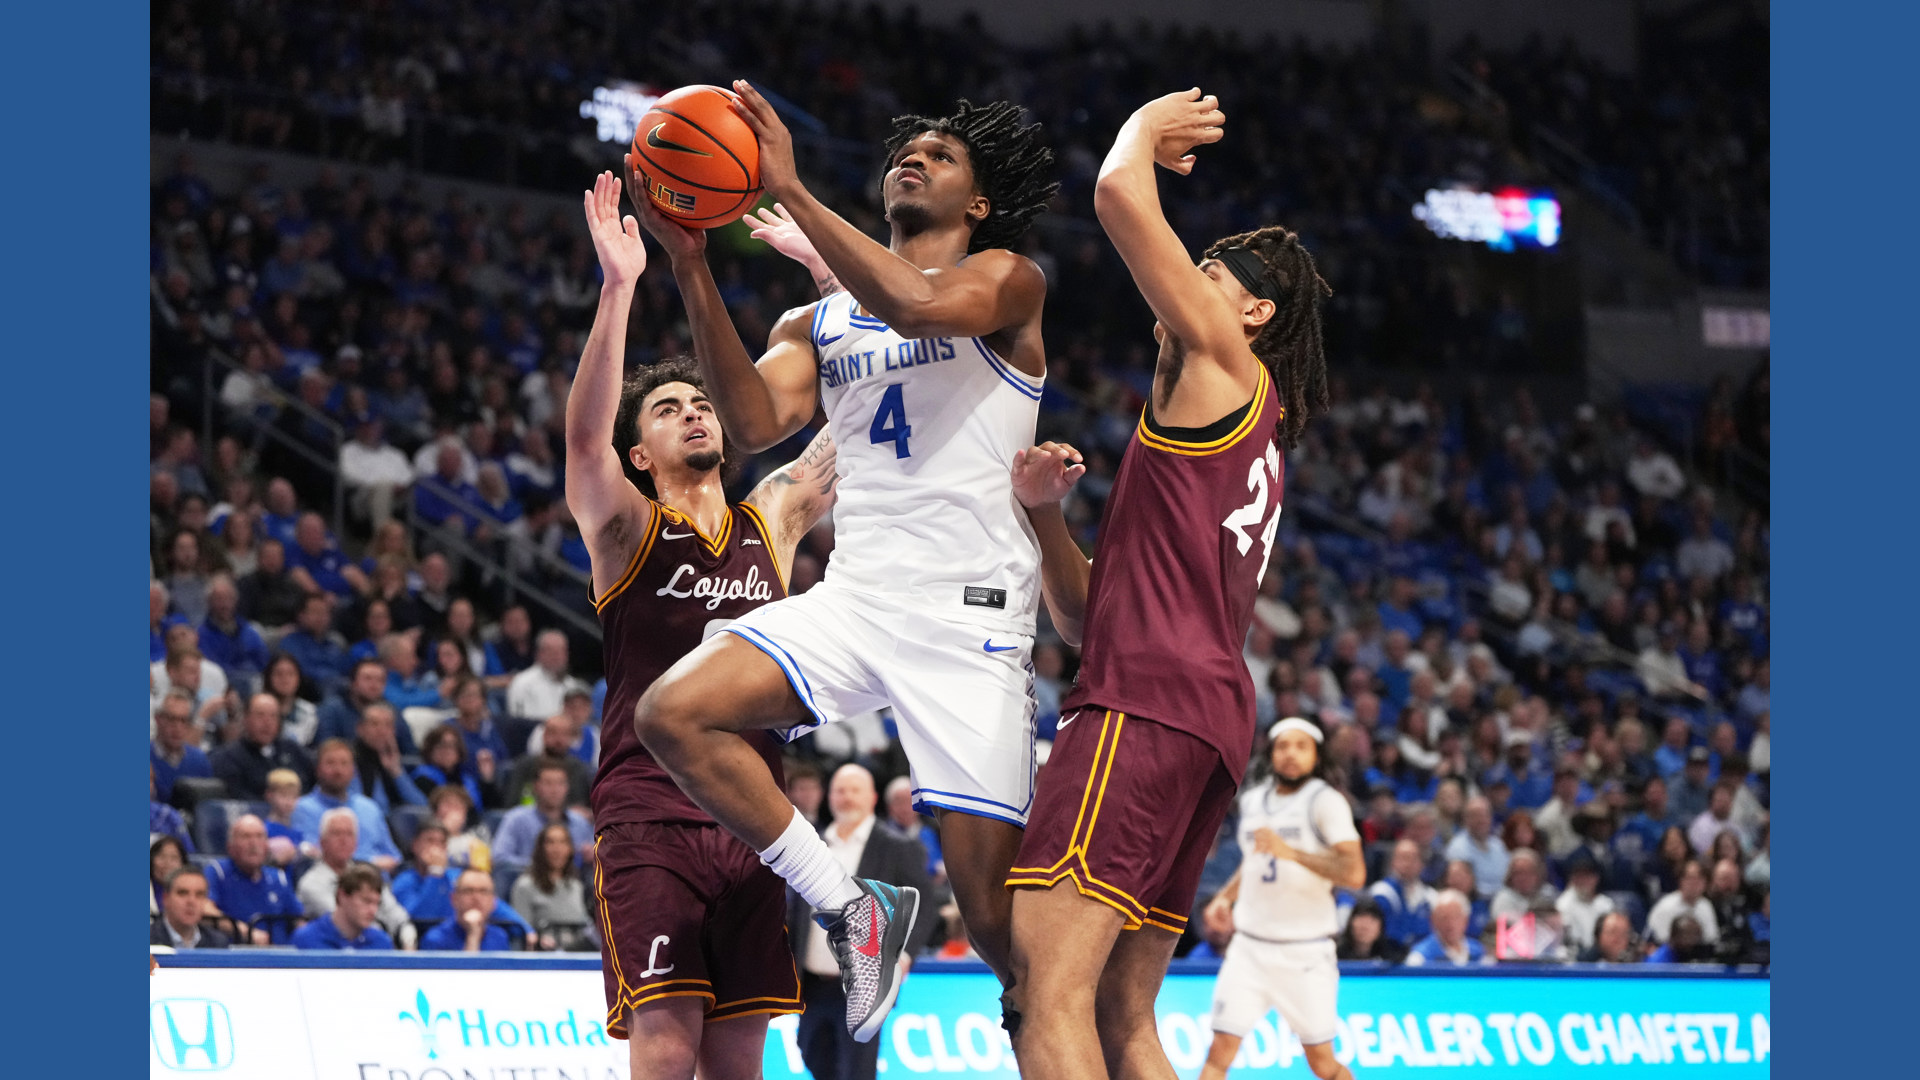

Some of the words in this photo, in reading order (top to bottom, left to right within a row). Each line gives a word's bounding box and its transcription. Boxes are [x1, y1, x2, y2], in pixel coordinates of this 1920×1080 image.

[820, 350, 876, 389] SAINT
[885, 336, 957, 373] LOUIS
[869, 383, 912, 460] 4
[656, 564, 772, 611] Loyola
[640, 935, 675, 979] L
[457, 1009, 609, 1047] Honda
[1486, 1012, 1556, 1067] TO
[1558, 1011, 1751, 1065] CHAIFETZ
